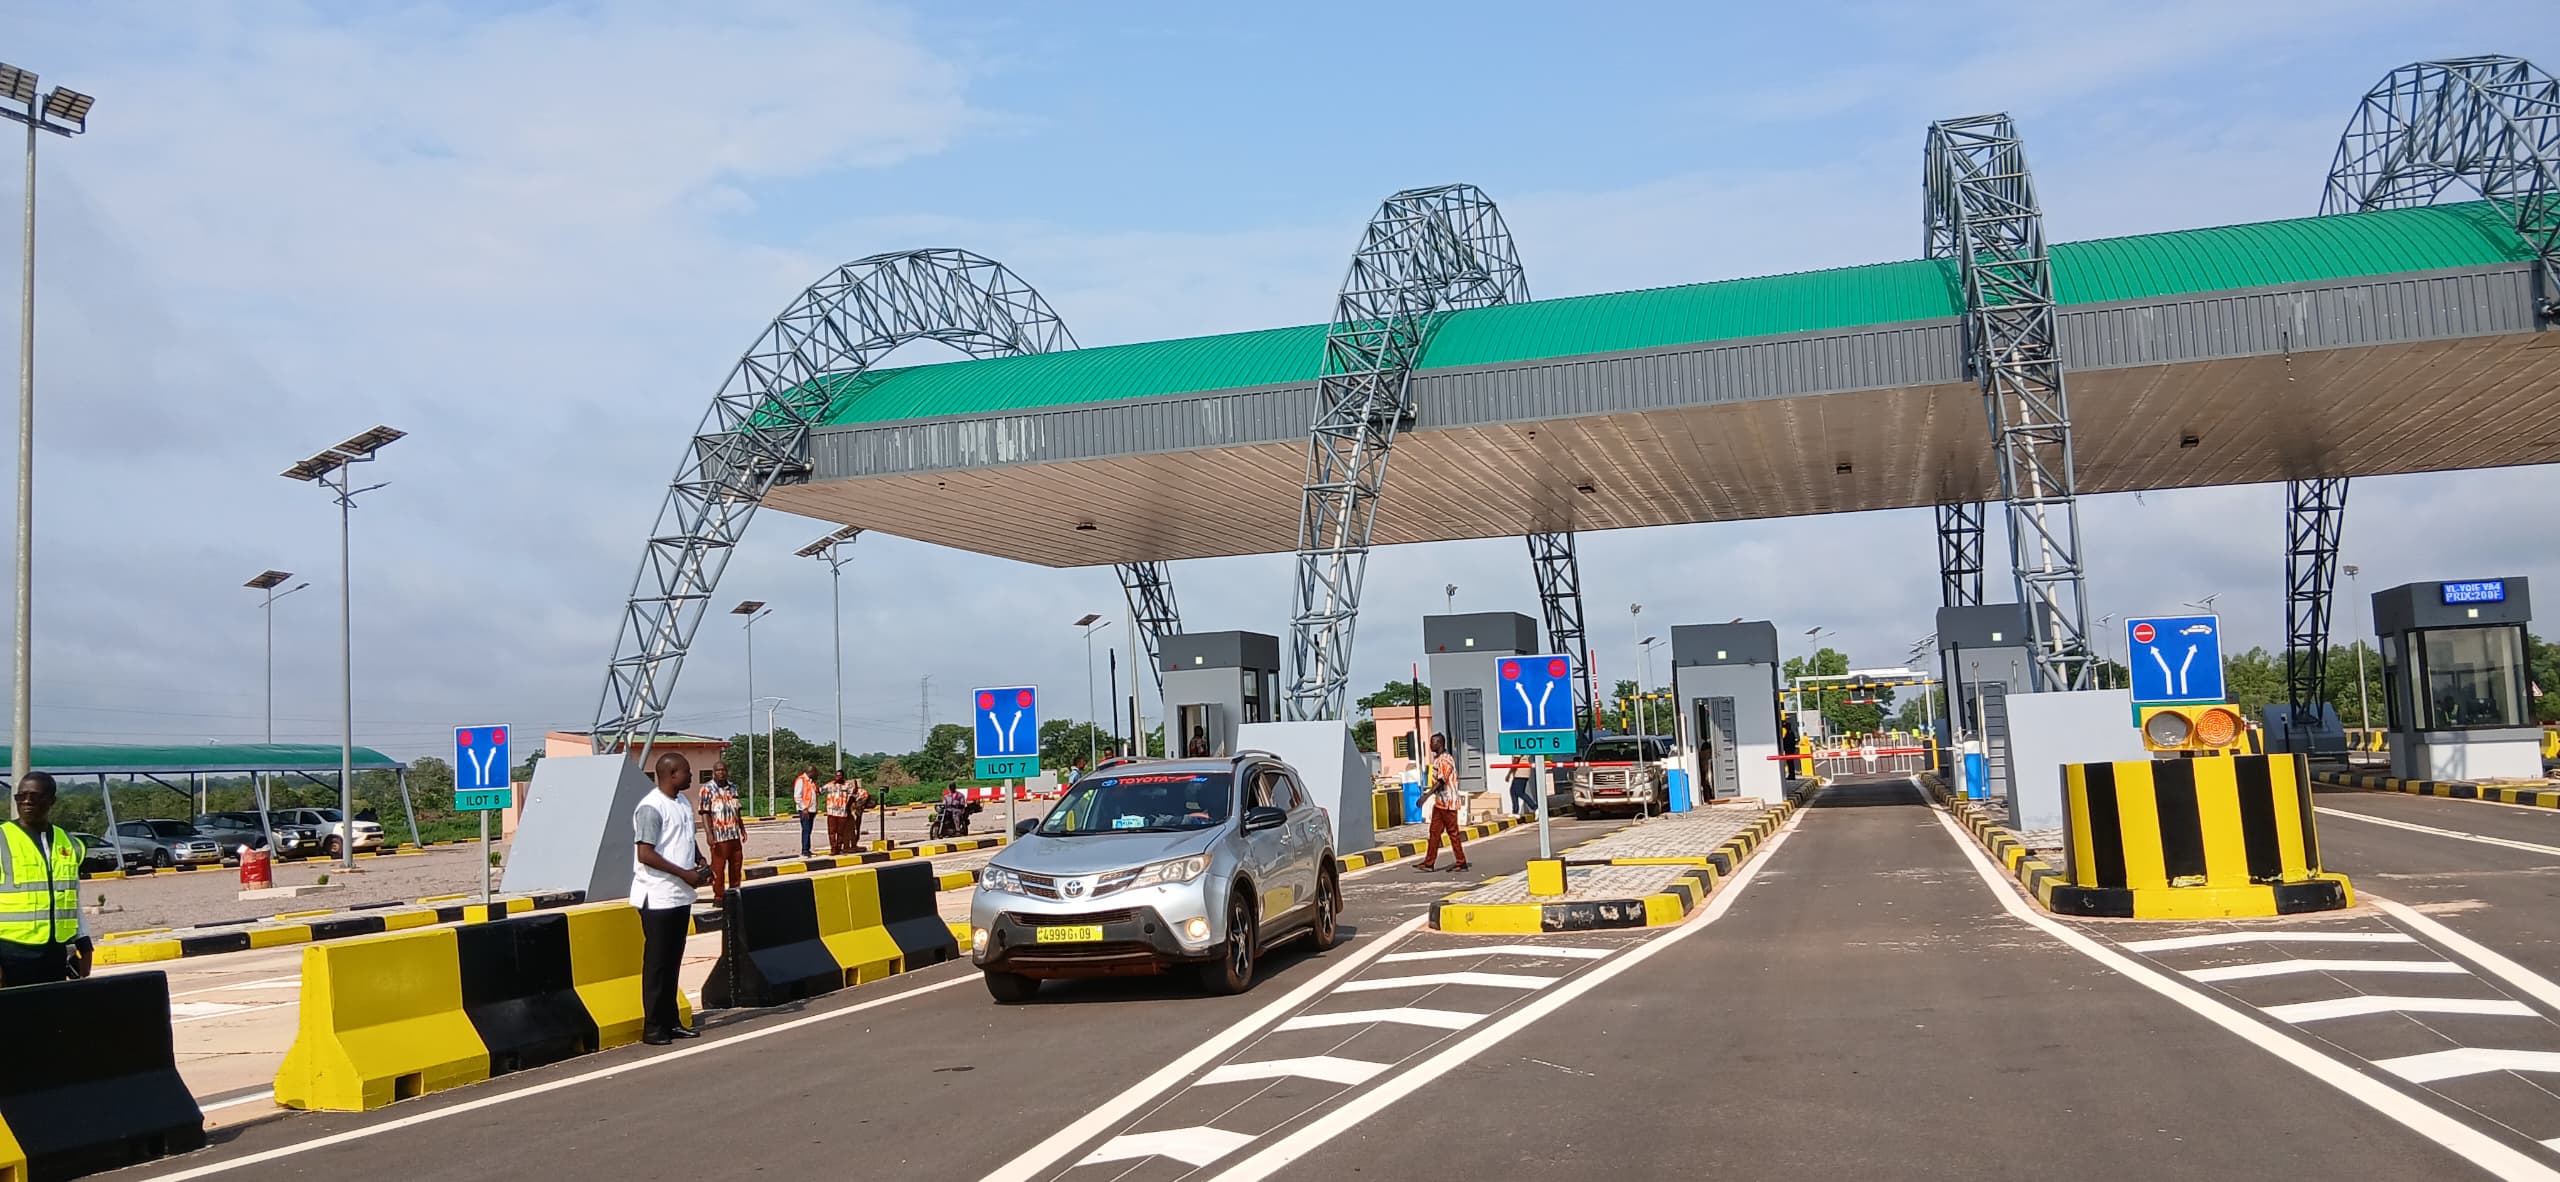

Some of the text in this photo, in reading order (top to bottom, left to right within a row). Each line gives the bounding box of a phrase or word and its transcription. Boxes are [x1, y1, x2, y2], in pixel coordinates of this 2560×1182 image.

[1513, 737, 1560, 749] ILOT 6
[988, 763, 1026, 774] ILOT 7
[466, 795, 500, 806] ILOT 8
